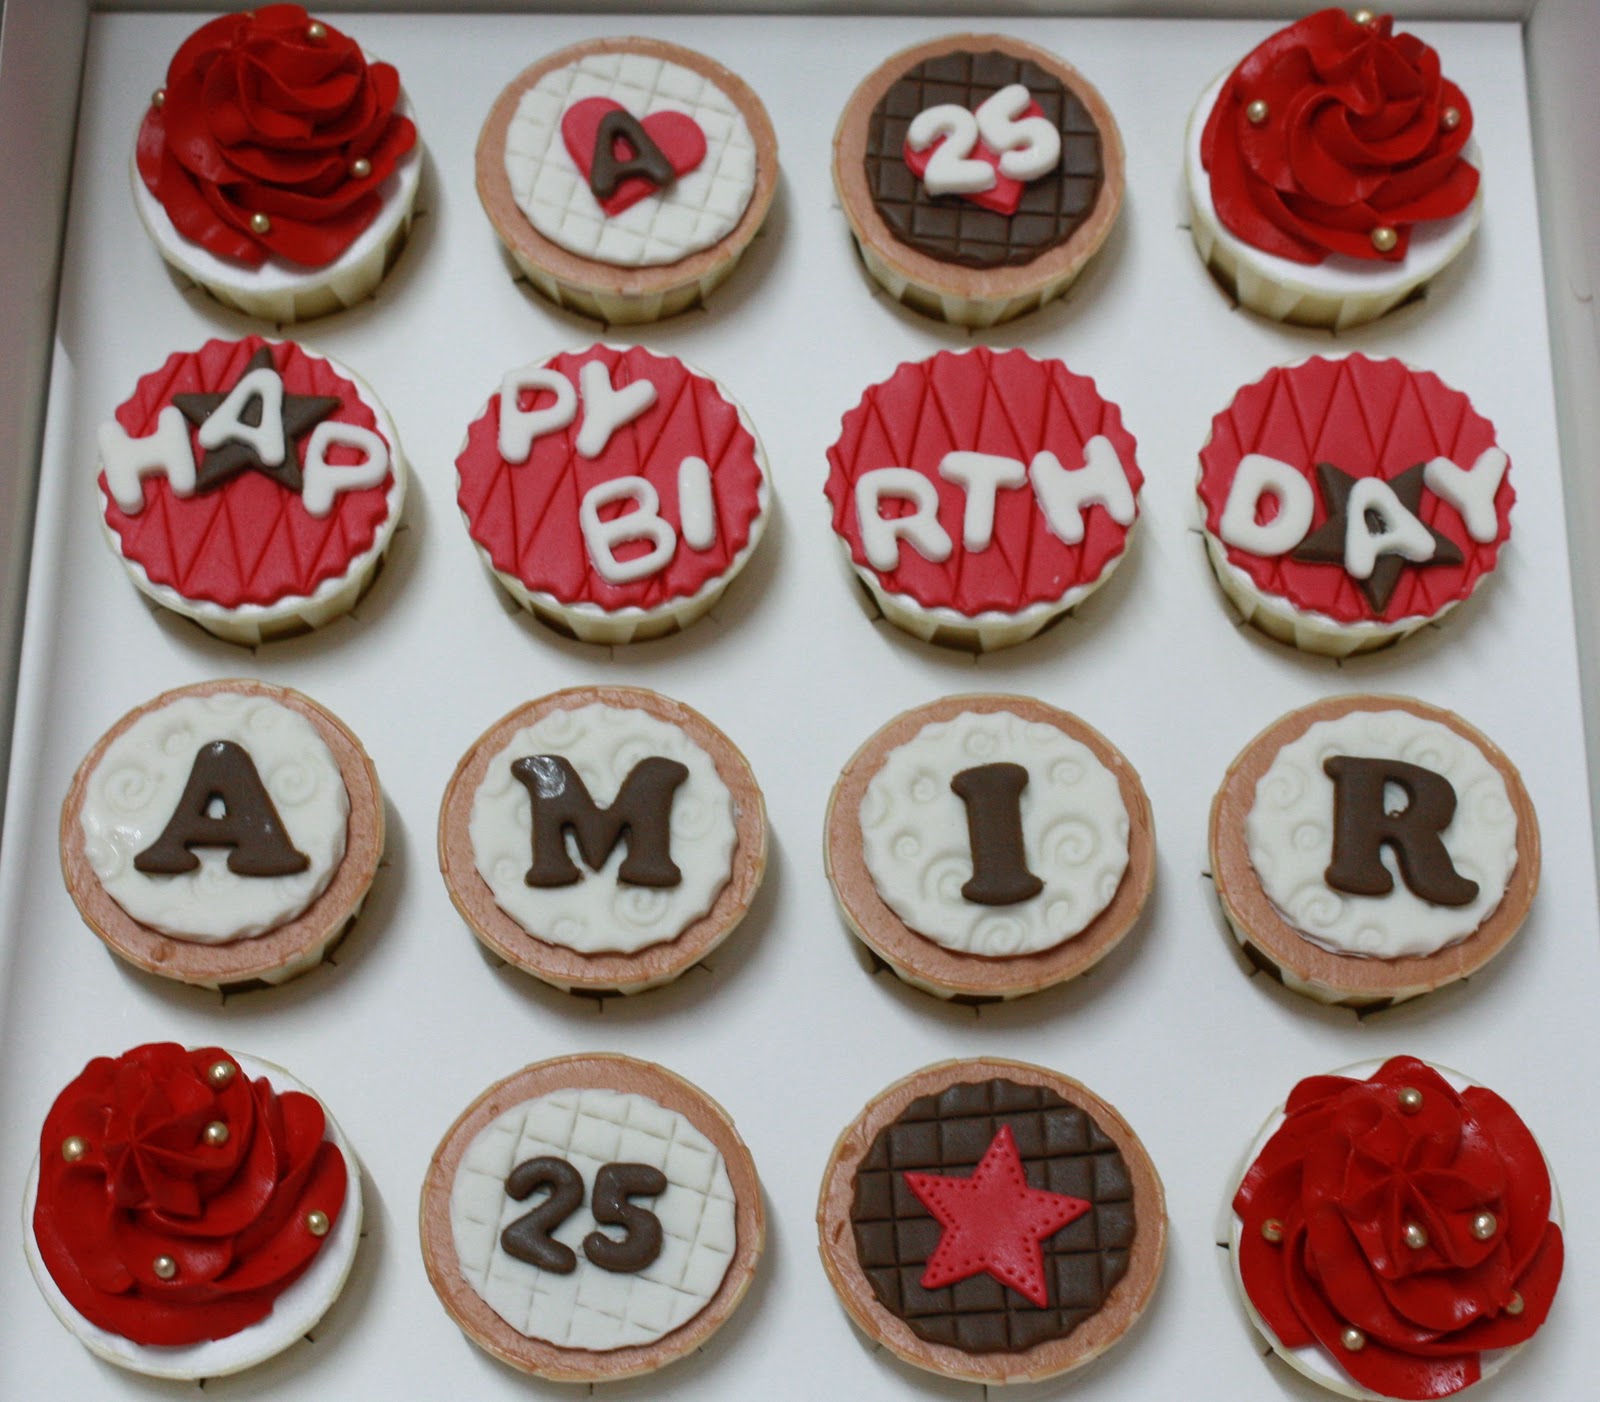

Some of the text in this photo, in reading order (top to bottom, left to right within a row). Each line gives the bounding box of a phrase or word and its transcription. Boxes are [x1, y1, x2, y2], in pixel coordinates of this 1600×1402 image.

[590, 110, 676, 199] A
[907, 84, 1062, 196] 25
[1220, 446, 1507, 579] DAY
[501, 1156, 668, 1274] 25
